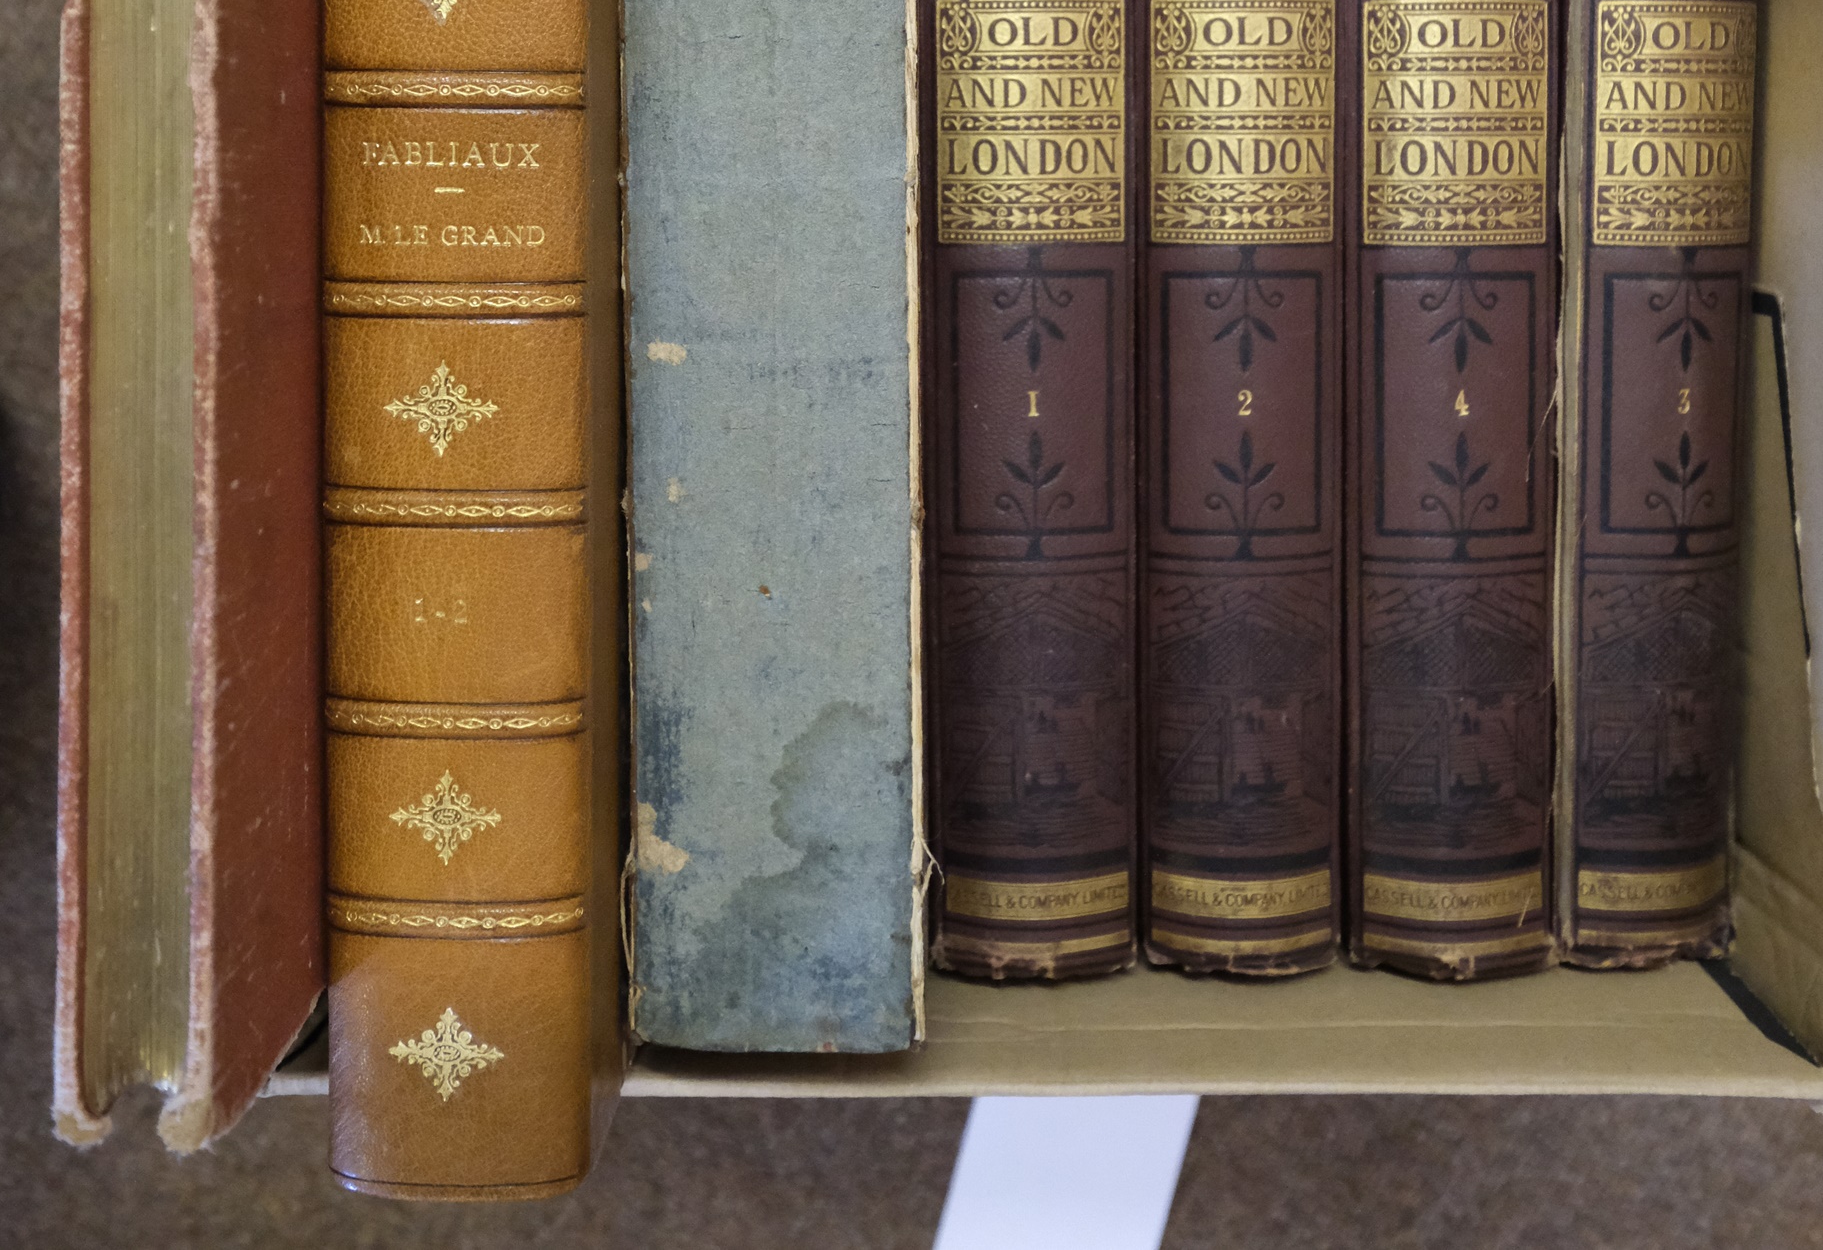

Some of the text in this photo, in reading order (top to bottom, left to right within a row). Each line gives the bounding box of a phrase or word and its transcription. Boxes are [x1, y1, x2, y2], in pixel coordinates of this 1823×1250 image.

[988, 16, 1079, 47] OLD
[1203, 16, 1293, 47] OLD
[1417, 19, 1506, 49] OLD
[1651, 20, 1730, 51] OLD
[944, 76, 1118, 108] AND NEW
[1159, 77, 1329, 108] AND NEW
[1371, 79, 1542, 110] AND NEW
[1604, 80, 1750, 111] AND NEW
[362, 140, 540, 168] FABLIAUX
[947, 137, 1117, 175] LONDON
[1161, 137, 1328, 175] LONDON
[1374, 139, 1540, 176] LONDON
[1604, 139, 1748, 178] LONDON
[394, 224, 429, 246] LE
[441, 224, 546, 247] GRAND
[1237, 389, 1253, 416] 2
[1454, 389, 1470, 417] 4
[1677, 388, 1691, 415] 3
